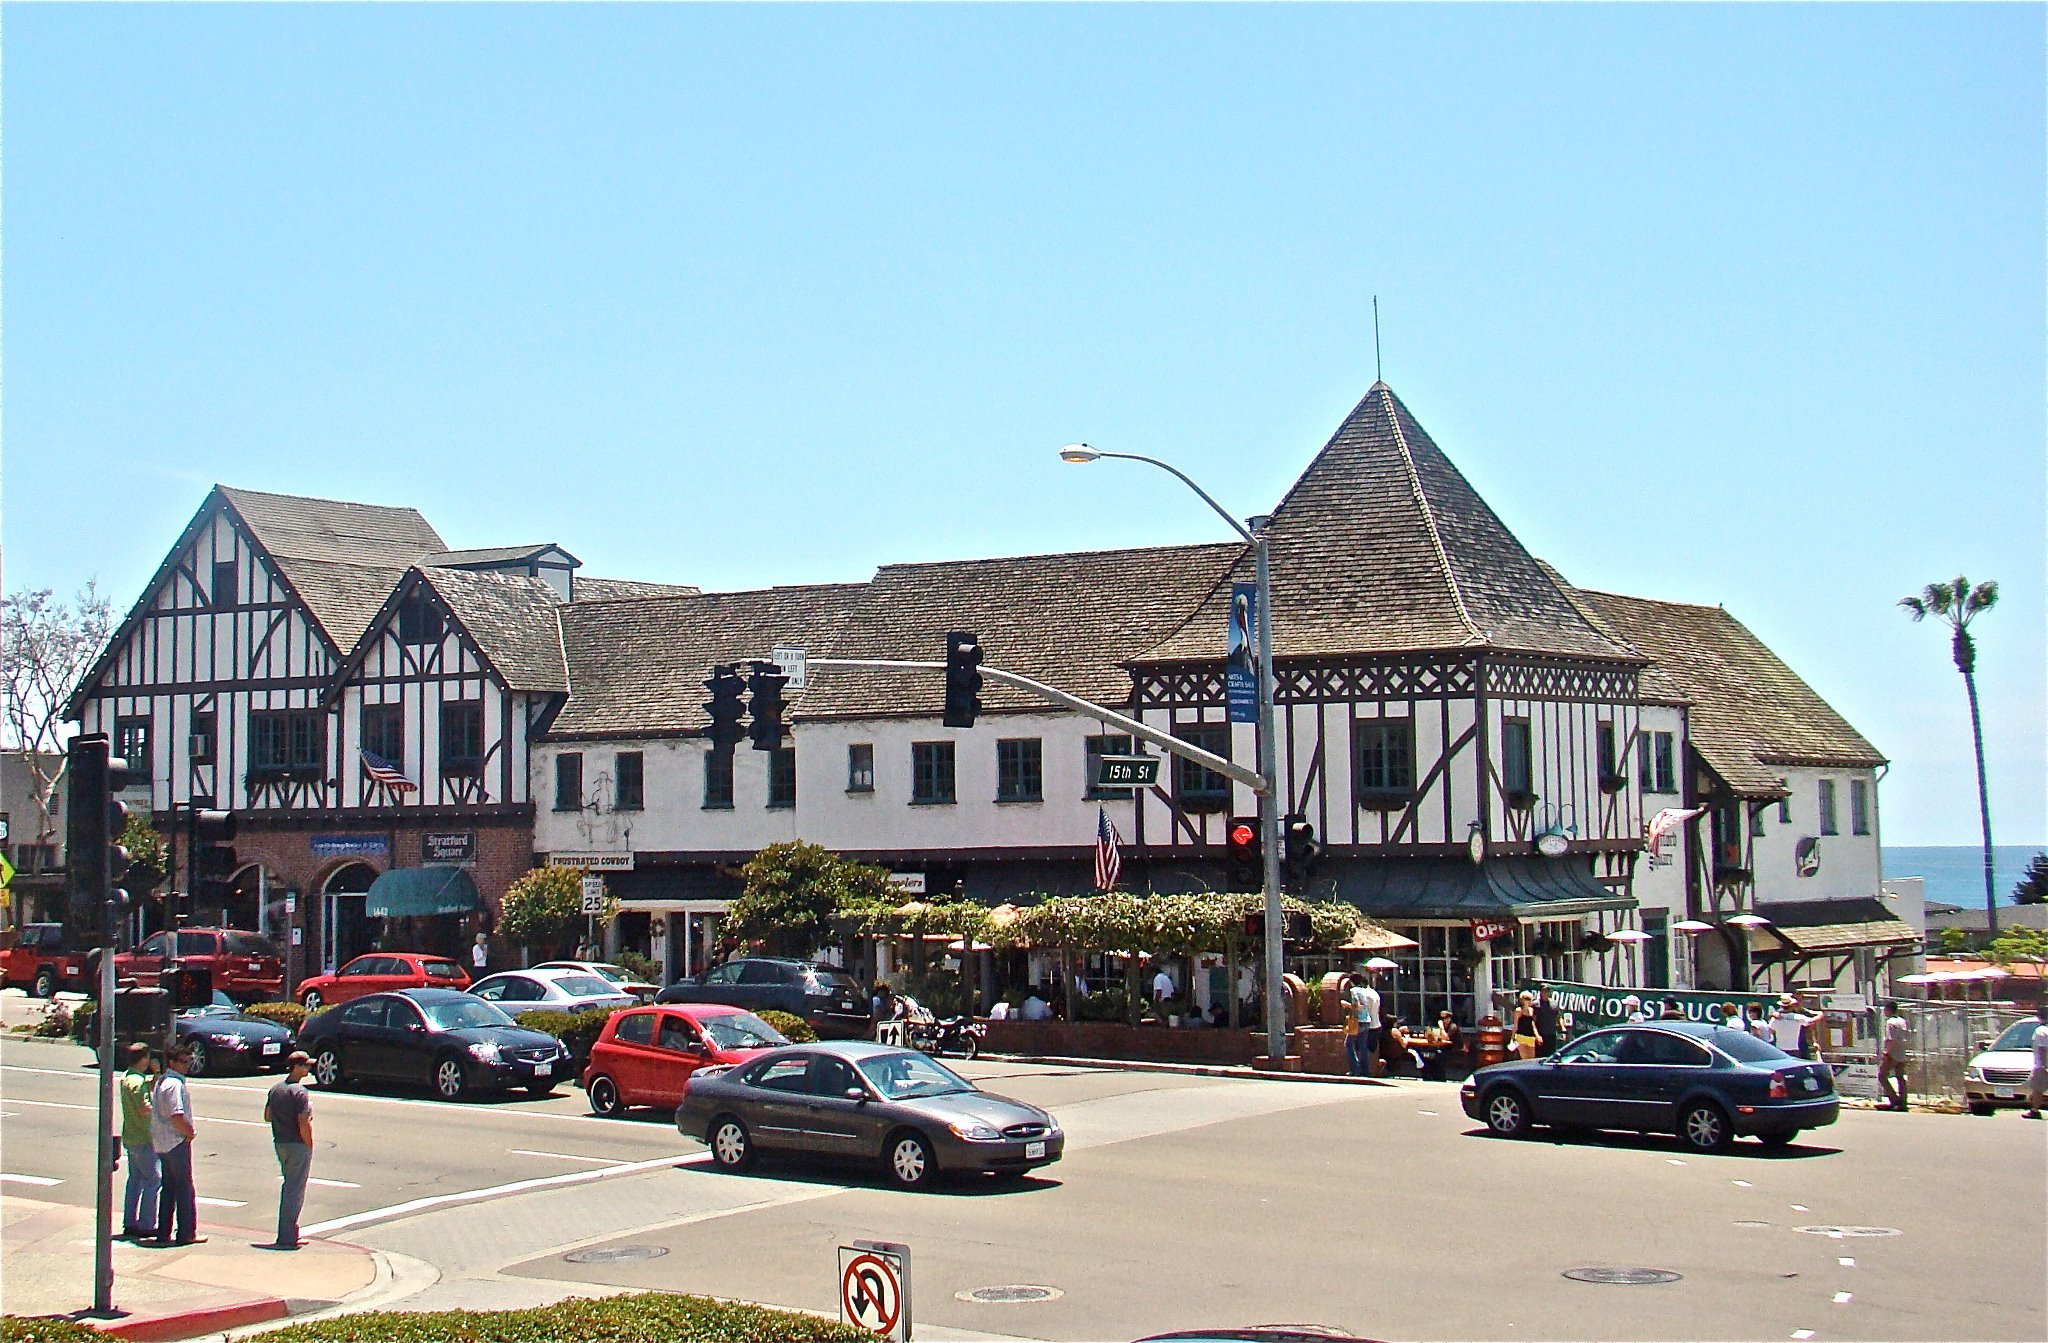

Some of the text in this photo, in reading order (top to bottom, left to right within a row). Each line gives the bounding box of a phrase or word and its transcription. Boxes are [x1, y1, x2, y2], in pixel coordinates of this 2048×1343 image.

[1109, 765, 1150, 779] 15th St
[553, 857, 630, 866] FRUSTRATED COWBOY
[584, 897, 601, 911] 25
[1476, 923, 1506, 939] OPE
[1551, 990, 1597, 1015] DURING
